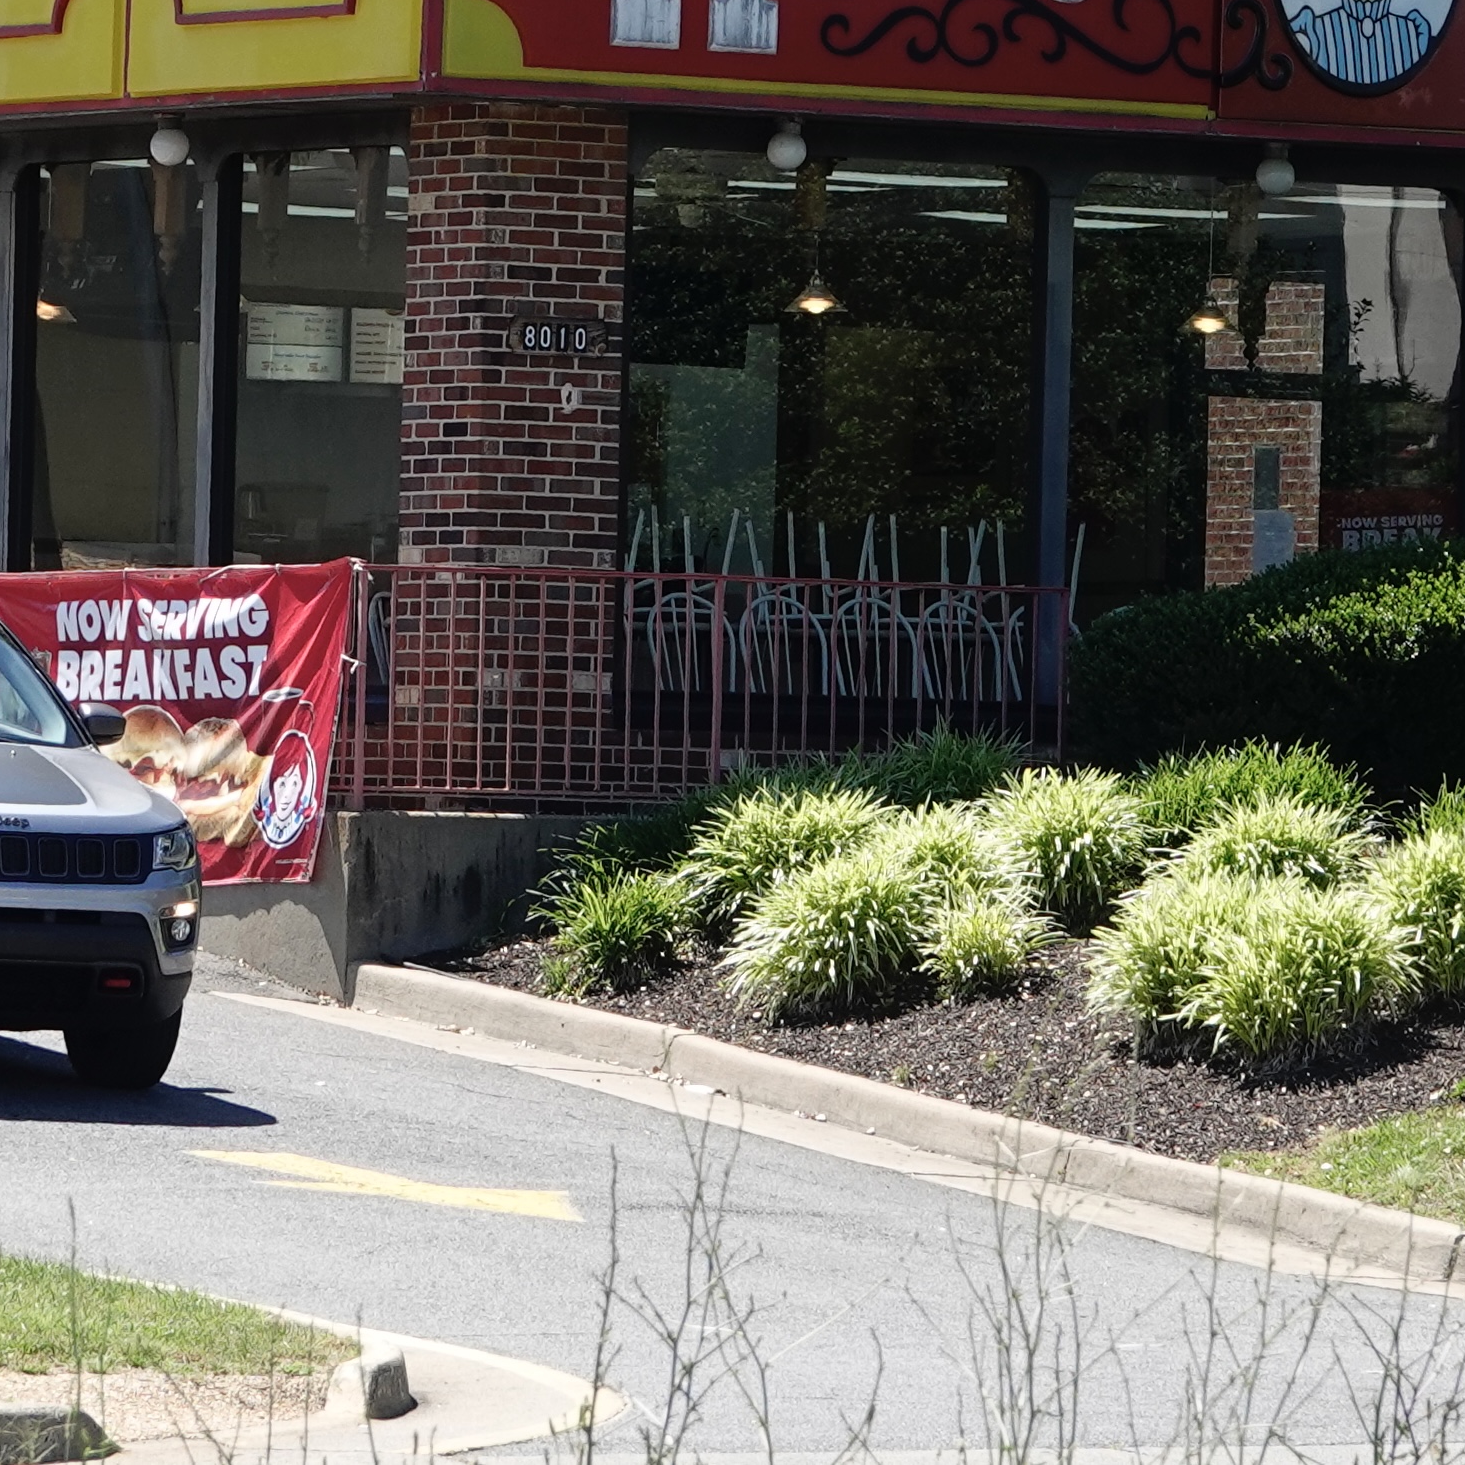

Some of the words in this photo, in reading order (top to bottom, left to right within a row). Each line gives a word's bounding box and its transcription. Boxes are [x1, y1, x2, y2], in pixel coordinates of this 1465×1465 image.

[524, 325, 586, 350] 8010
[1341, 516, 1377, 529] NOW
[1380, 513, 1444, 528] SERVING
[56, 598, 133, 642] NOW
[136, 593, 270, 642] SERVING
[56, 644, 268, 702] BREAKFAST
